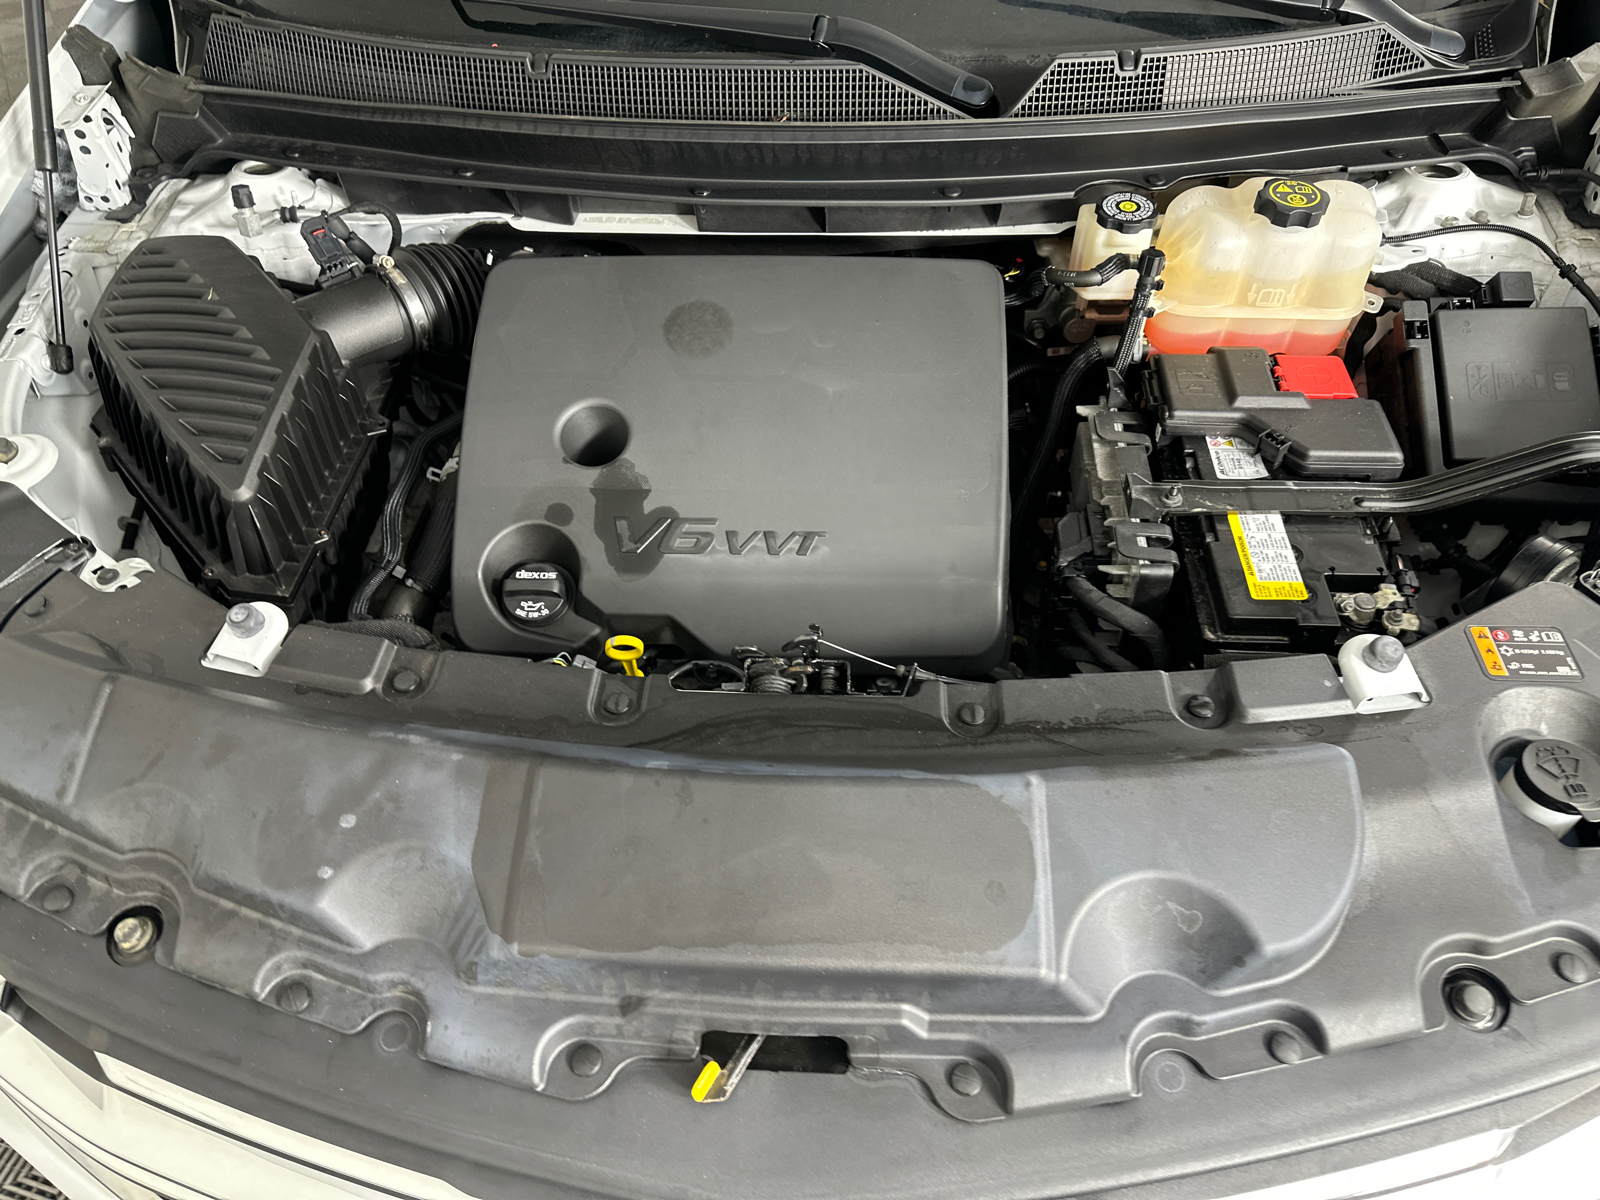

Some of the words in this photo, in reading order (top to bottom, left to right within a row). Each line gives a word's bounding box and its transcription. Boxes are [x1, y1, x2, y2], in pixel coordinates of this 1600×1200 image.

[614, 516, 719, 554] V6
[725, 530, 829, 556] VVT
[515, 569, 558, 579] dexos
